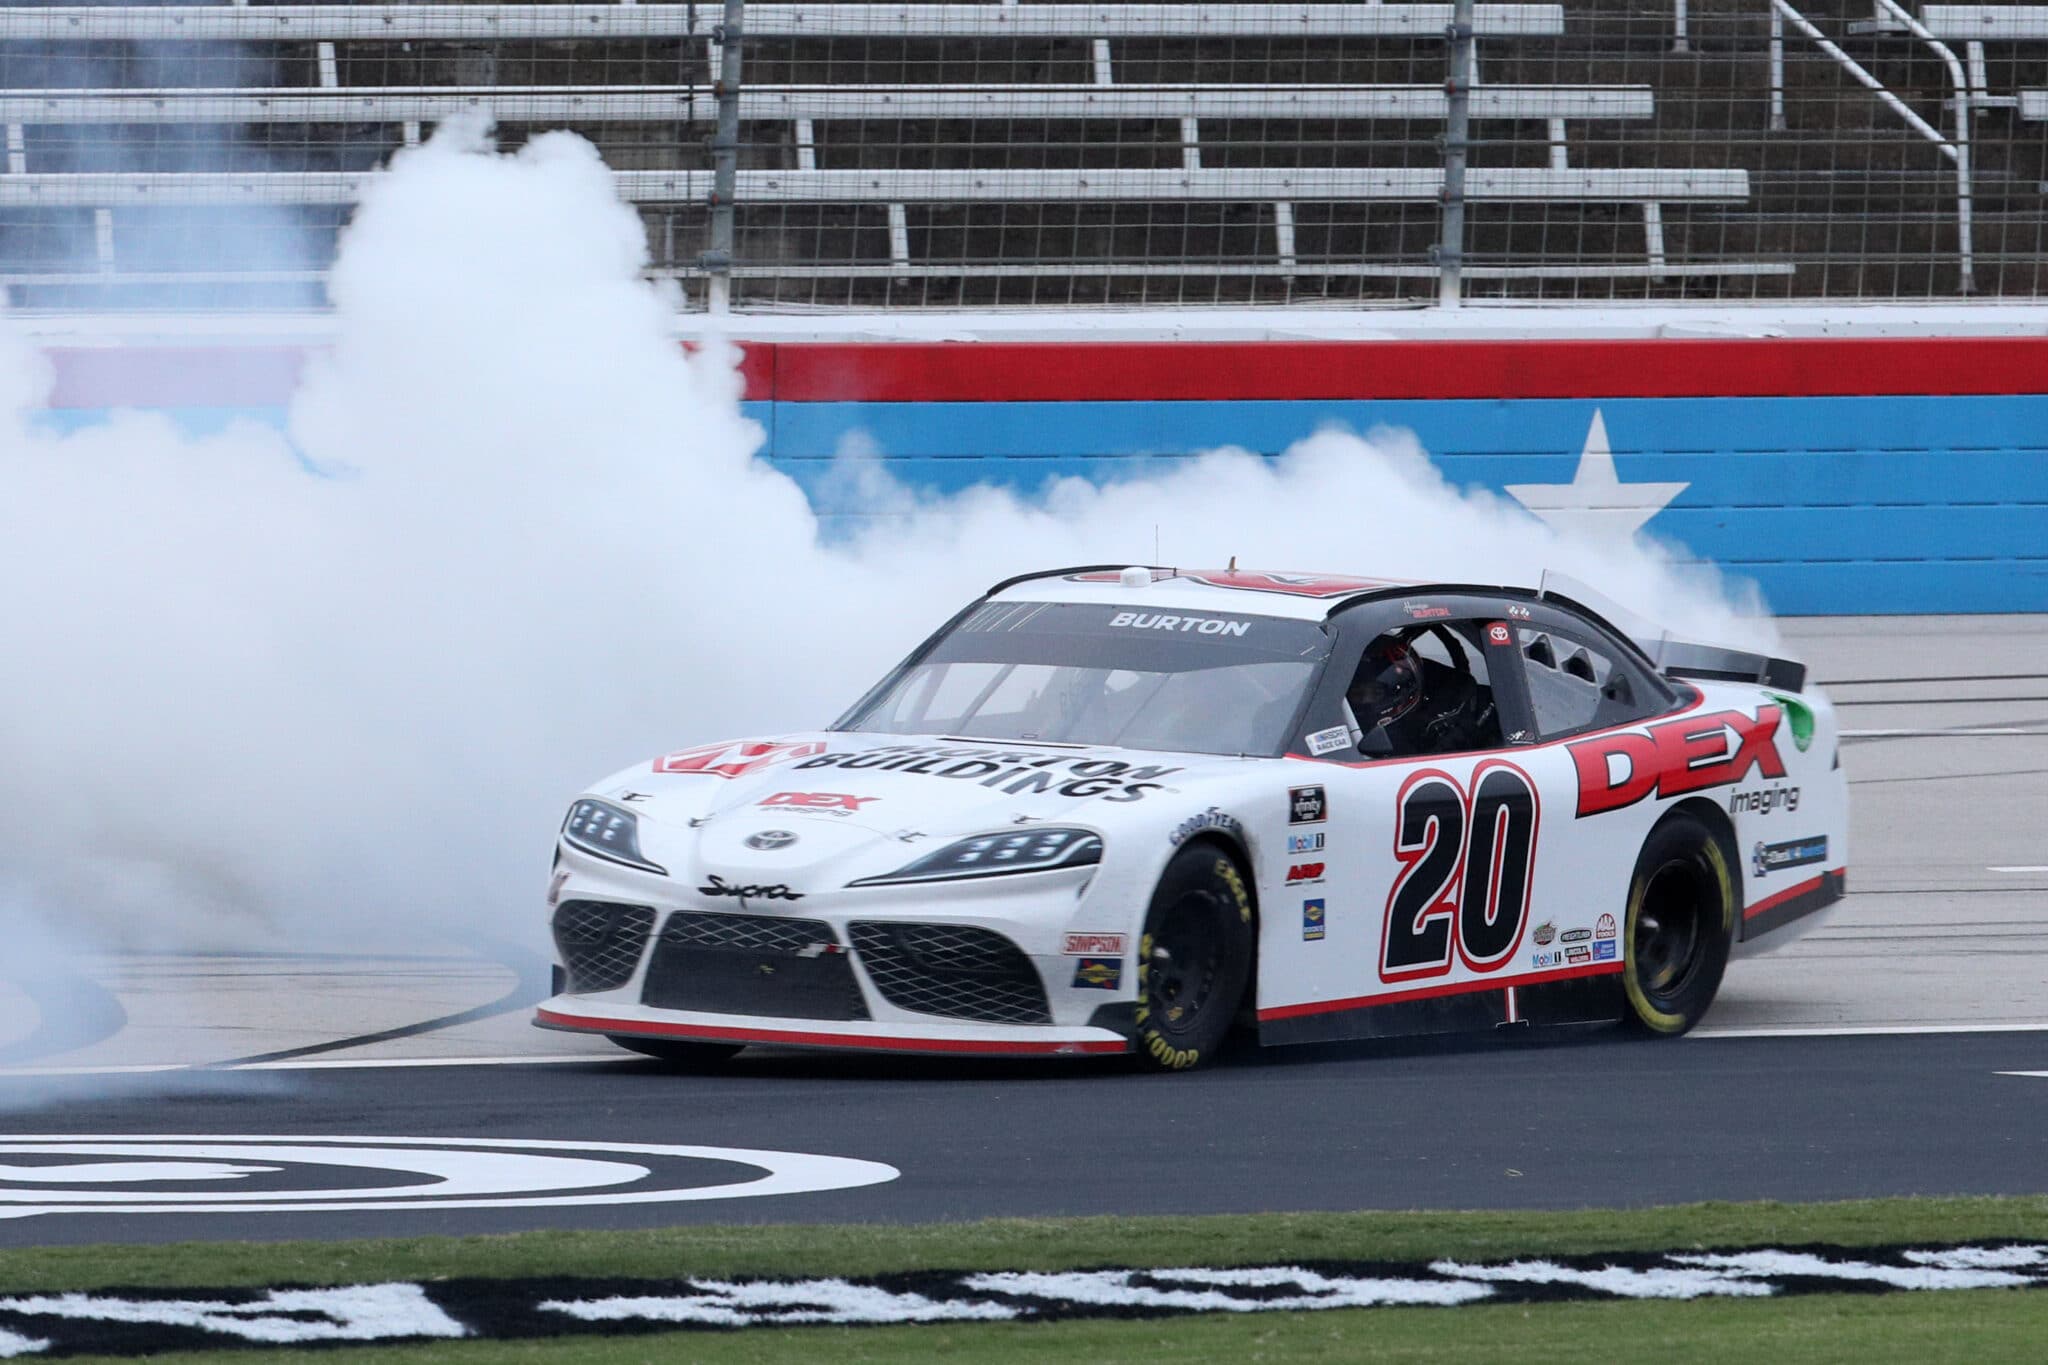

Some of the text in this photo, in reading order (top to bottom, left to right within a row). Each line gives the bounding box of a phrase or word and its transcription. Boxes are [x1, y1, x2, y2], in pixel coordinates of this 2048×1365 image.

[1109, 612, 1251, 637] BURTON
[1564, 703, 1788, 819] DEX
[792, 752, 1164, 803] BUILDINGS
[755, 792, 884, 811] DEX
[1729, 783, 1800, 814] imaging
[1378, 758, 1541, 984] 20
[699, 874, 806, 910] Supra
[1066, 935, 1121, 953] SIMPSON
[1532, 953, 1552, 966] Mobil
[1554, 951, 1561, 963] 1
